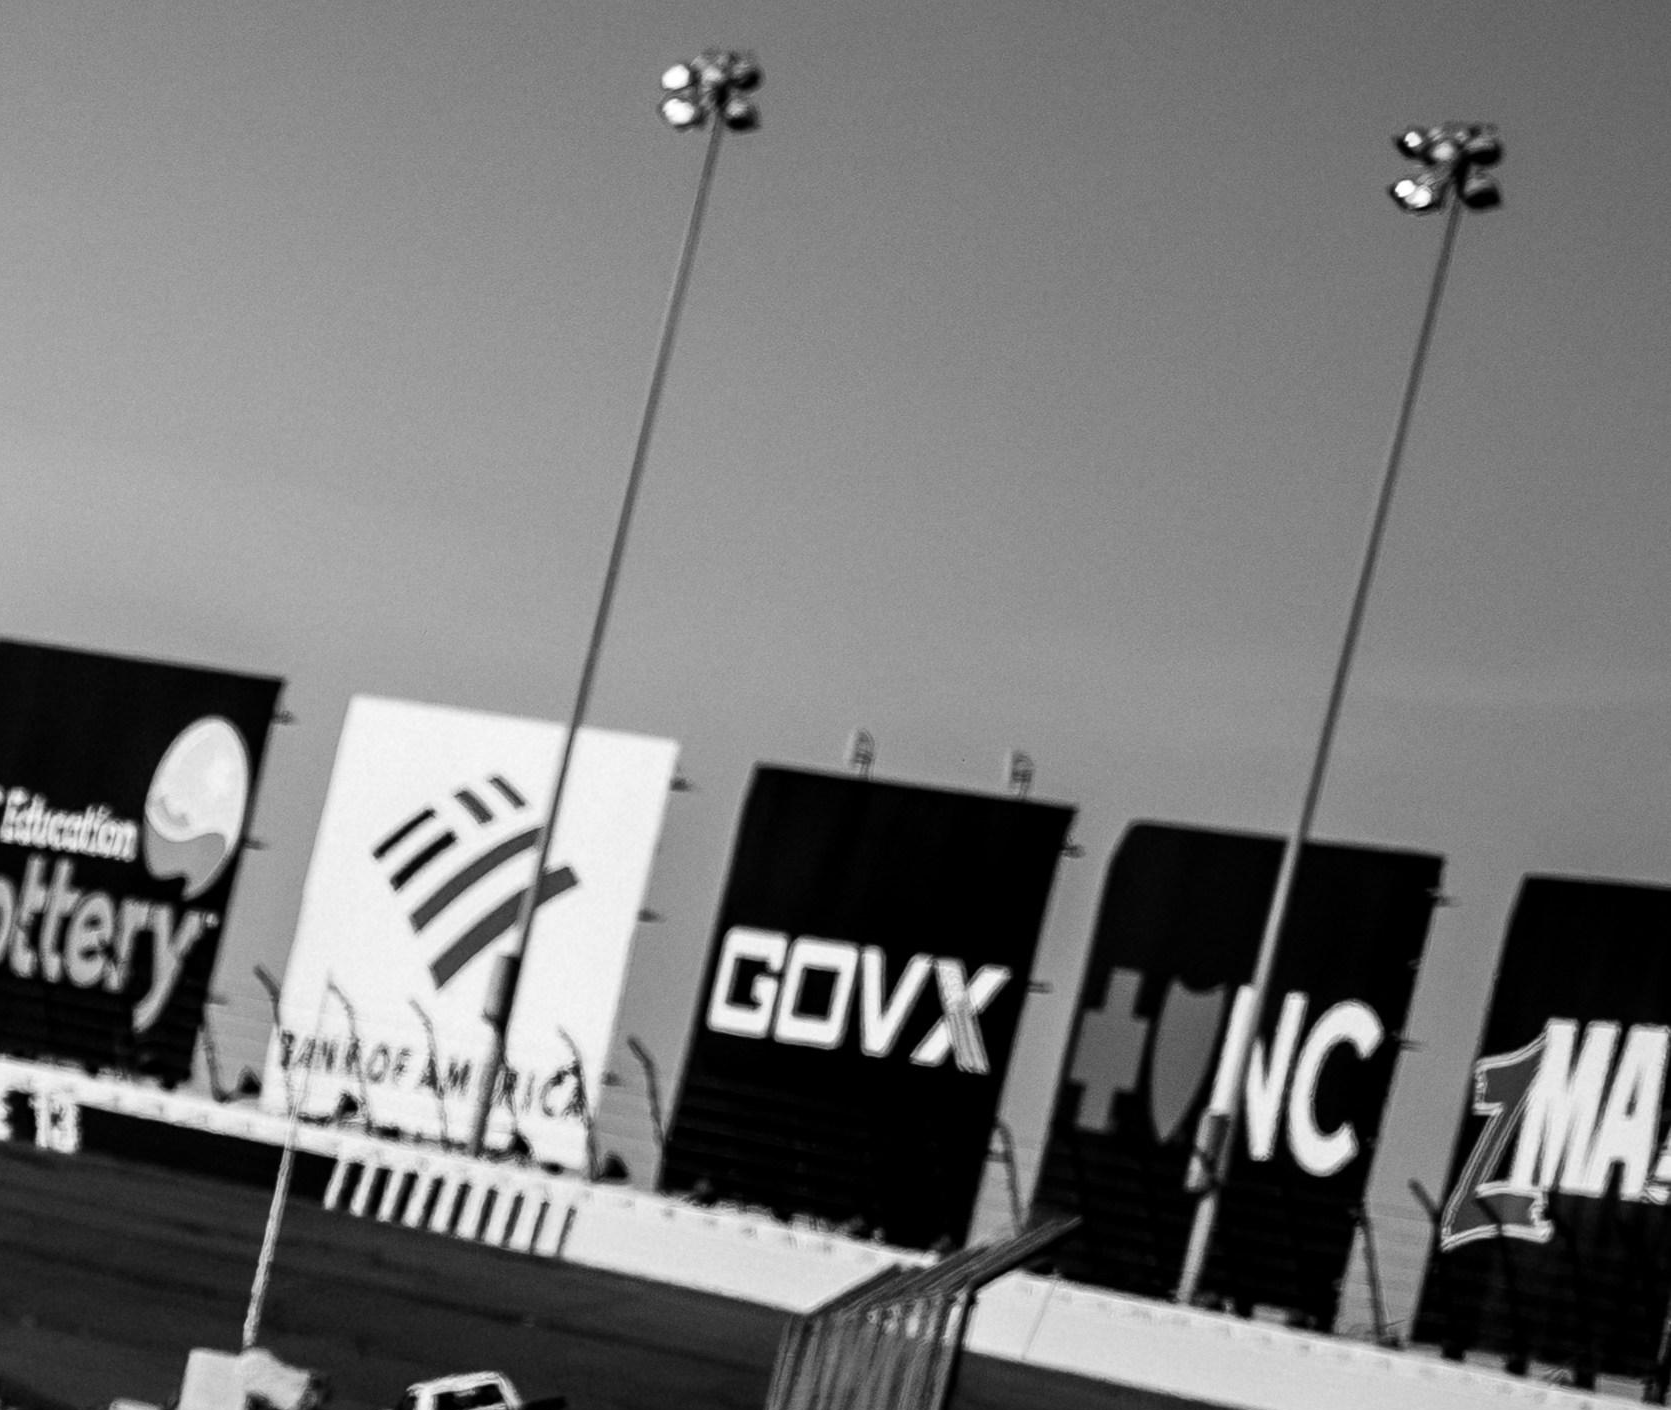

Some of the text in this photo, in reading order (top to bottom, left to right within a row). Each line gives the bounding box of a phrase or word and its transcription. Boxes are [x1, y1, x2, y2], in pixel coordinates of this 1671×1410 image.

[0, 785, 139, 863] Education
[705, 926, 1010, 1072] GOVX
[1509, 1016, 1671, 1204] MA
